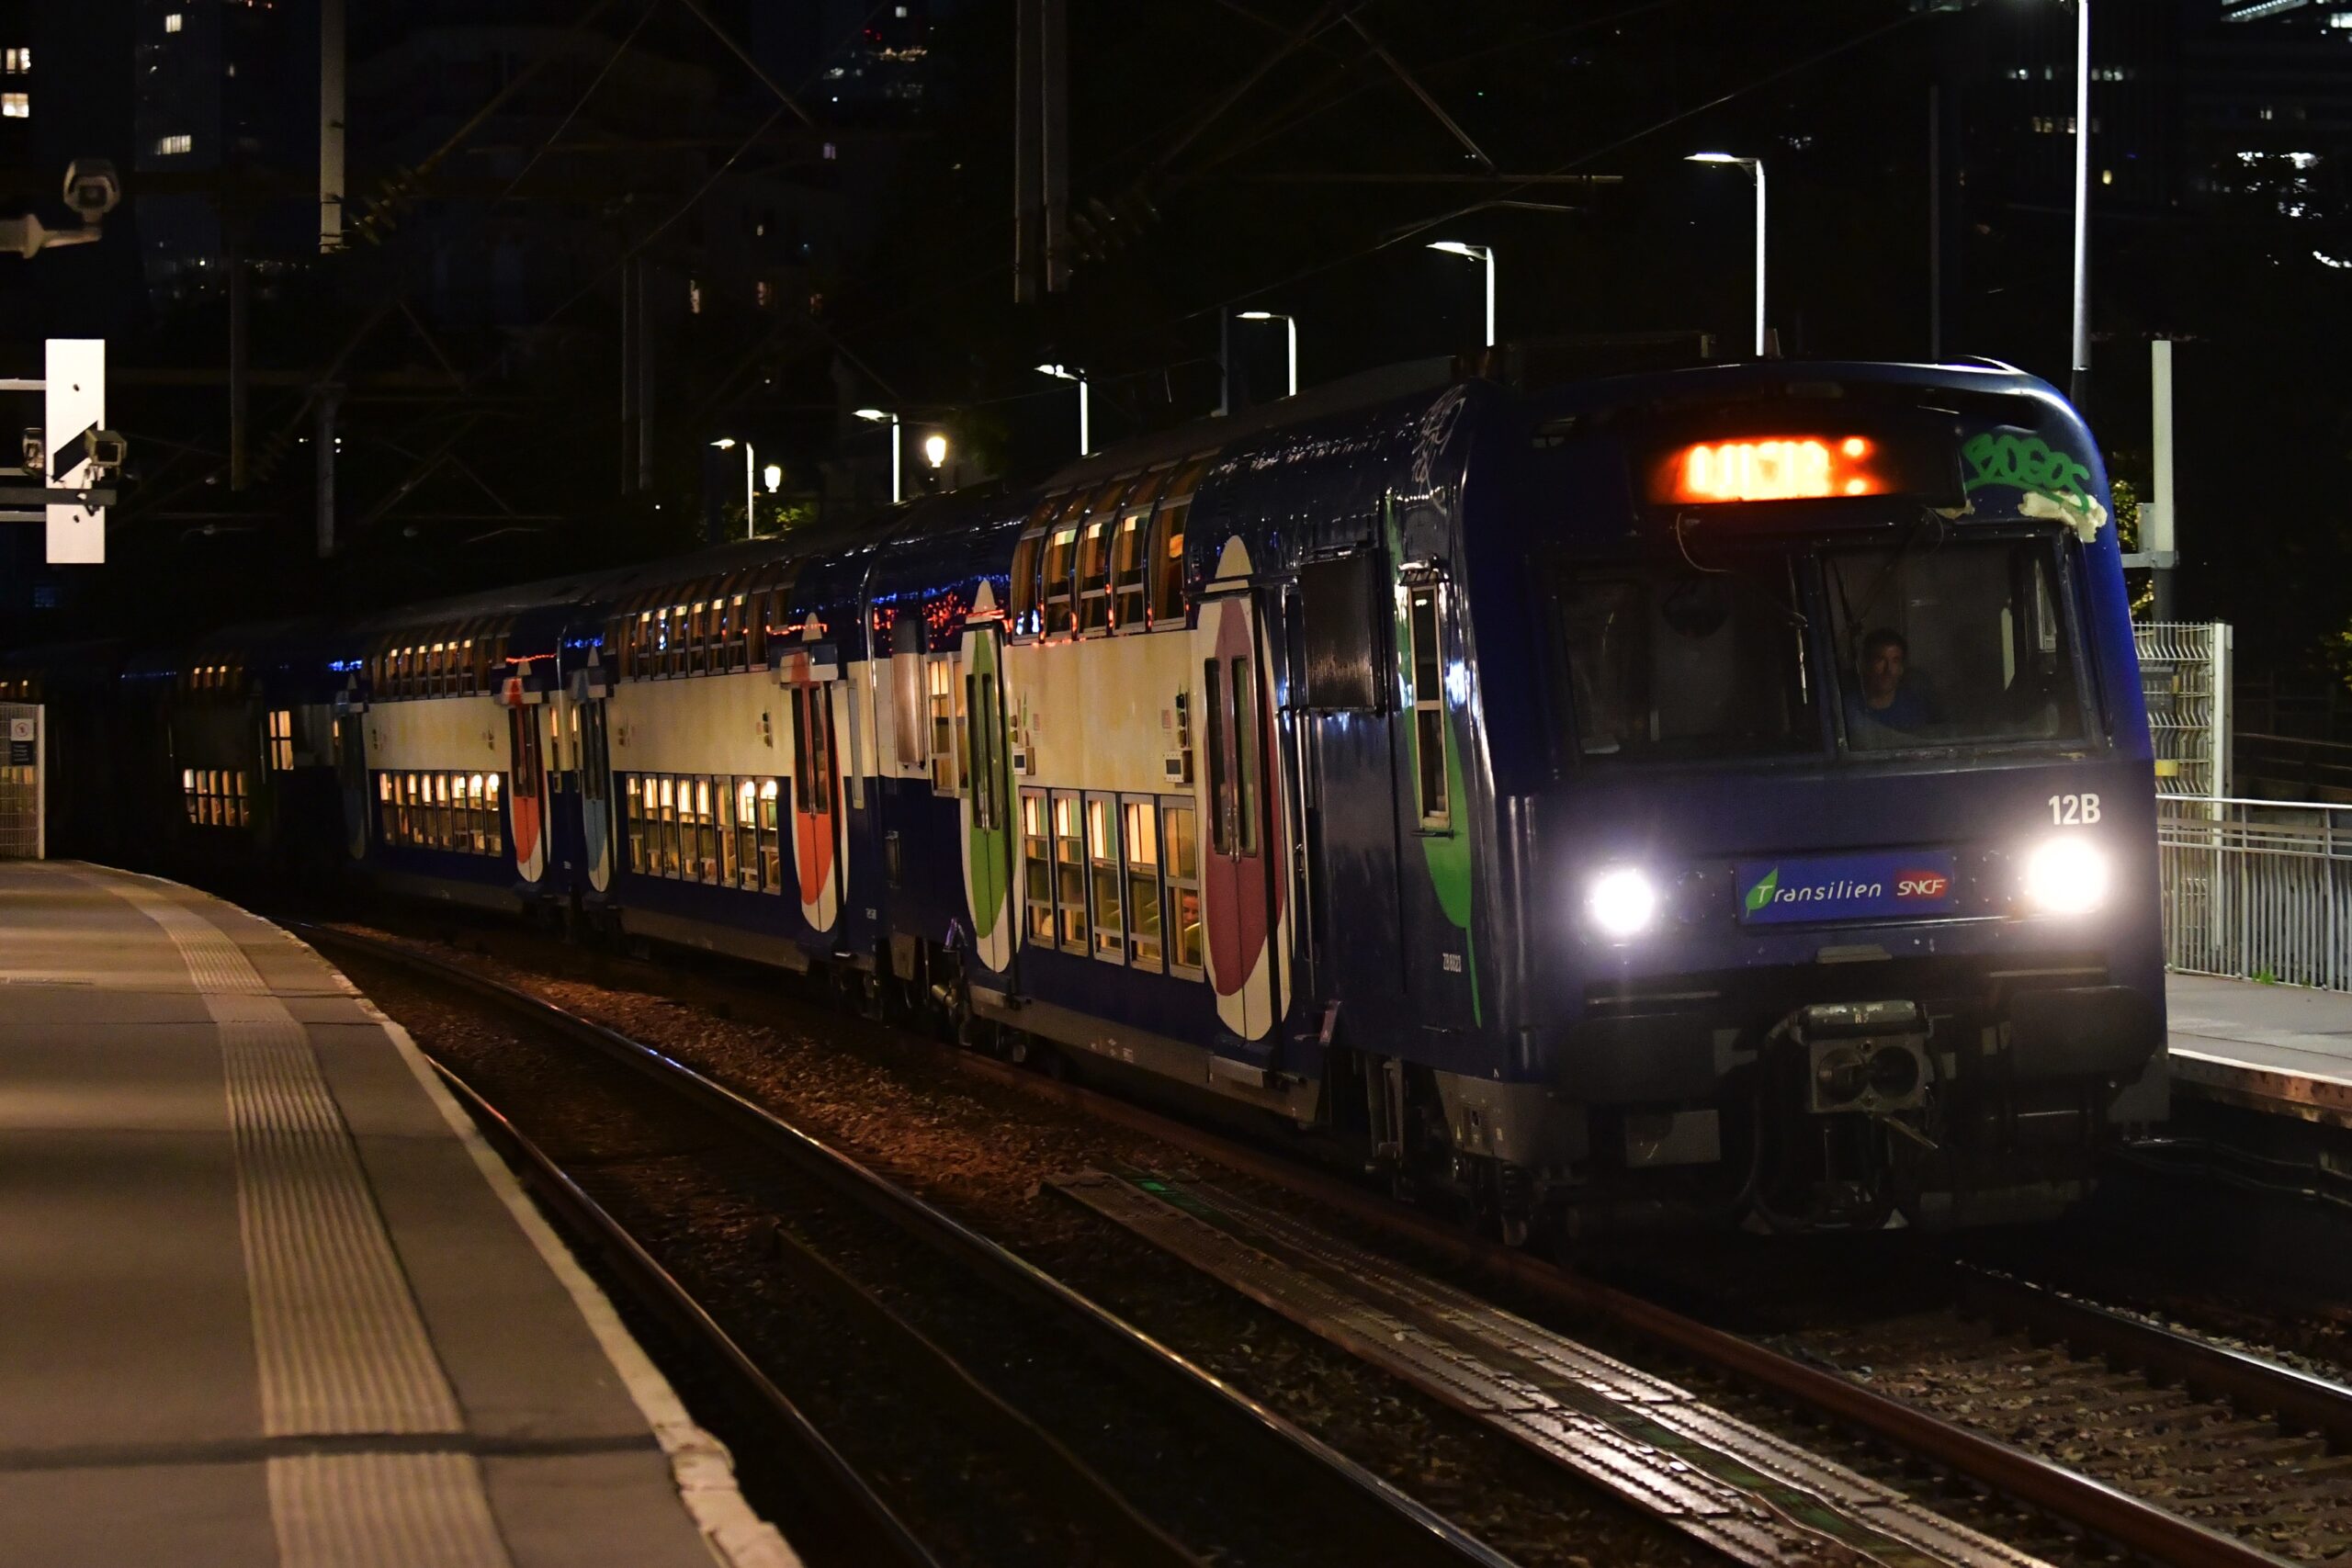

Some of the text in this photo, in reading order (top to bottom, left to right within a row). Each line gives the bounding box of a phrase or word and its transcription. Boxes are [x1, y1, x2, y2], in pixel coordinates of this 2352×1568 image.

[2048, 793, 2101, 825] 12B
[1758, 878, 1947, 904] Transilien SNCF
